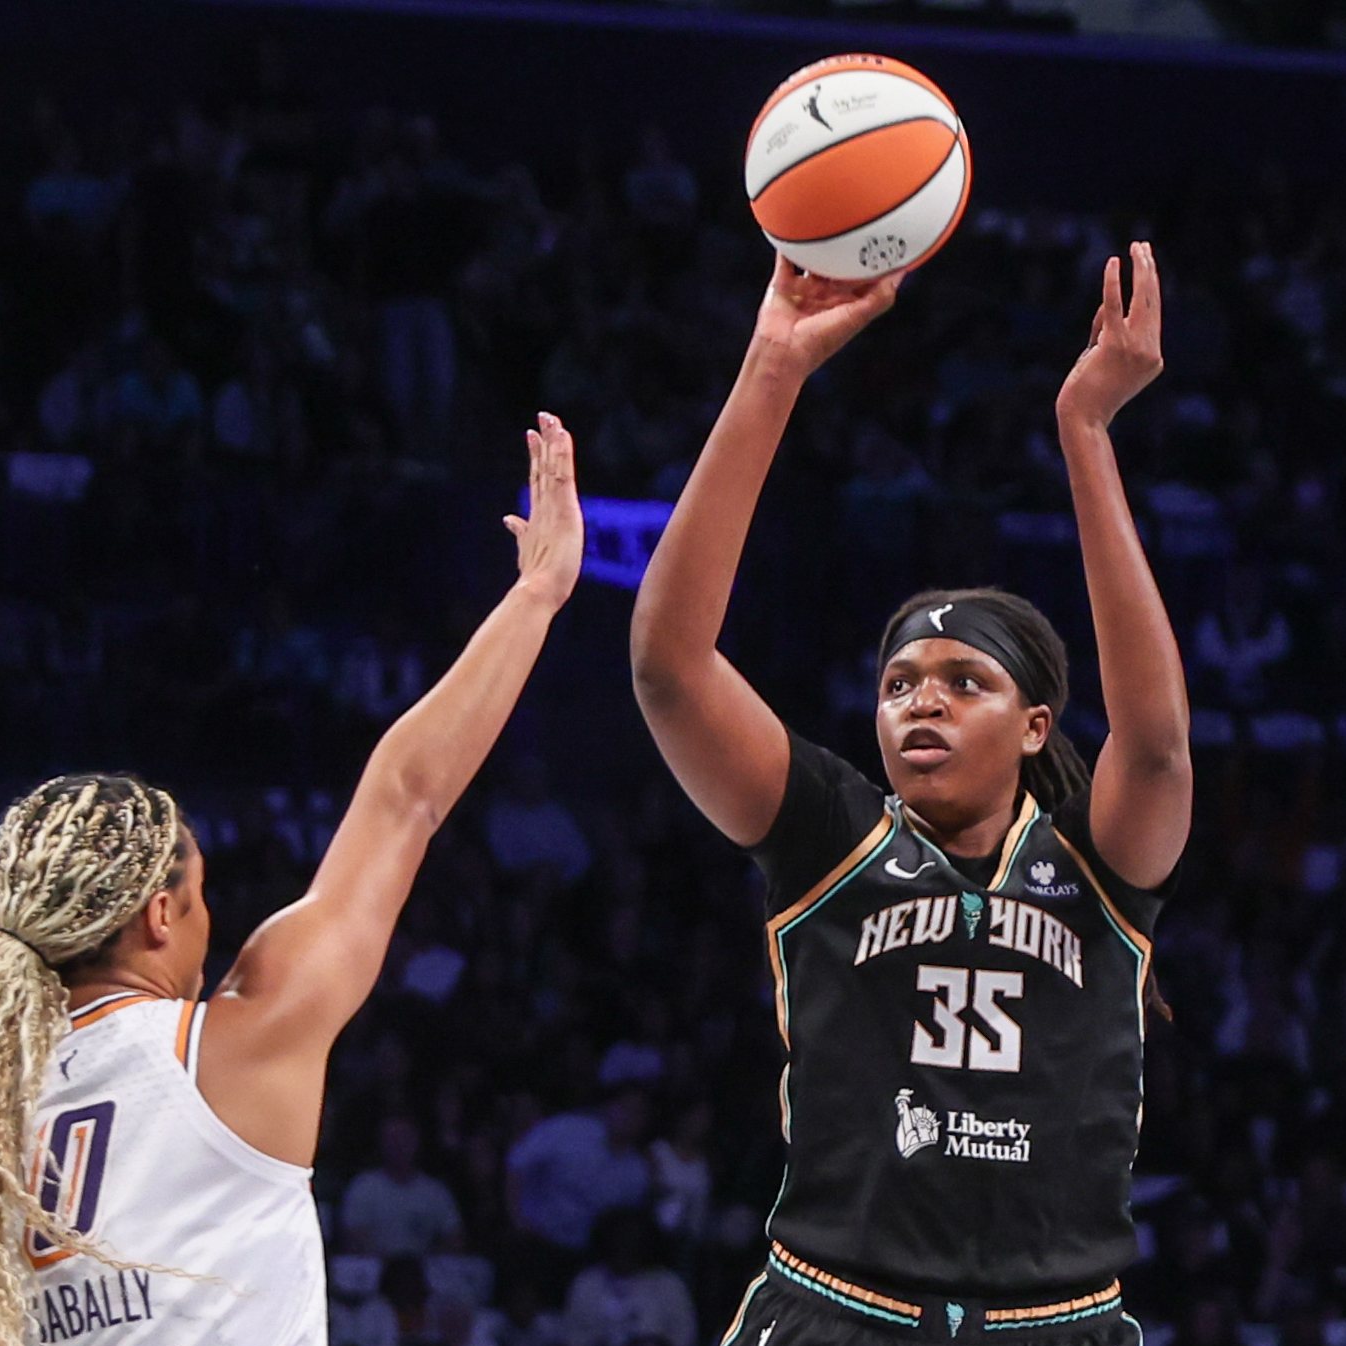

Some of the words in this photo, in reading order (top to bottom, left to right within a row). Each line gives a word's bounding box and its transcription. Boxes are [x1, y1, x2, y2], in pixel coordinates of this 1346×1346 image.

[854, 895, 956, 967] NEW
[988, 896, 1083, 989] YORK
[911, 965, 1024, 1072] 35
[944, 1137, 1030, 1162] Mutual
[946, 1112, 1031, 1144] Liberty
